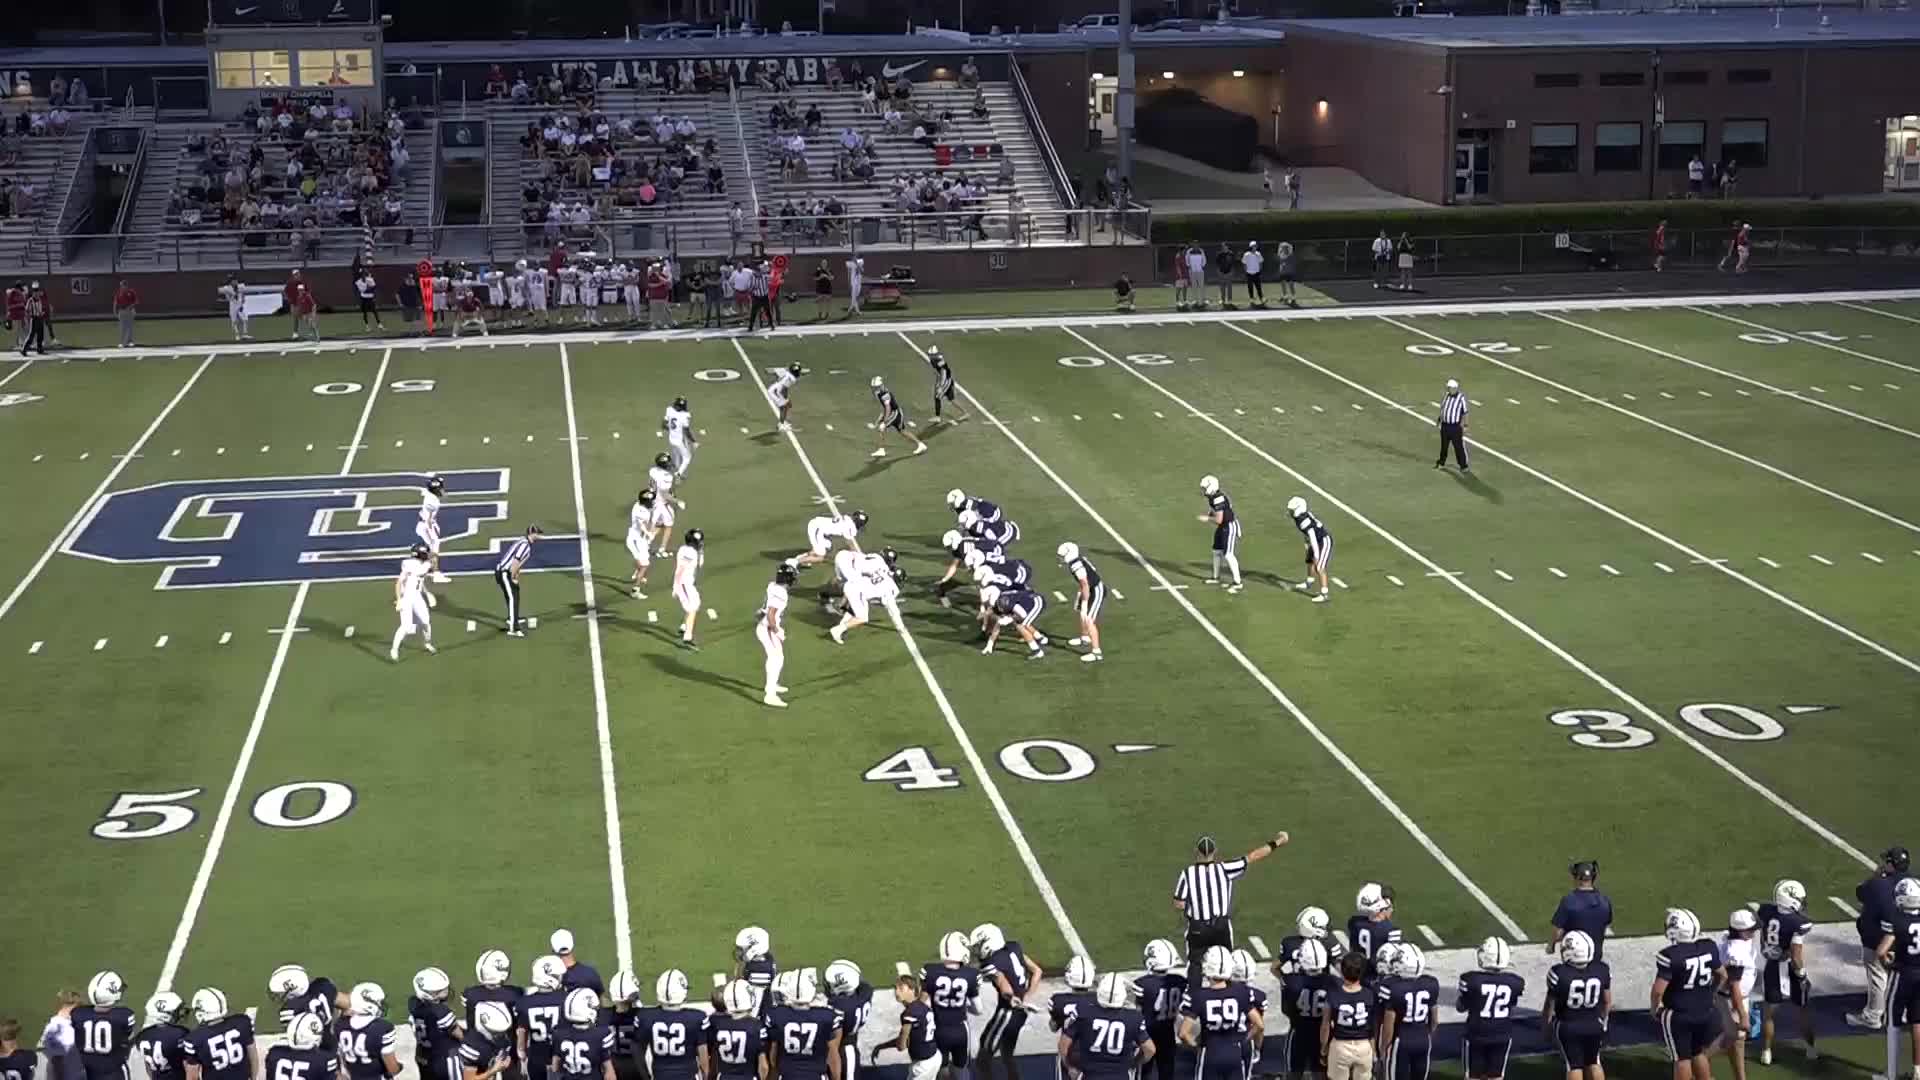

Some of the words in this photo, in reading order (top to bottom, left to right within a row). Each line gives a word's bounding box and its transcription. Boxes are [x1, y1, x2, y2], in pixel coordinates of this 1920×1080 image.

[614, 61, 664, 84] ALL
[1683, 953, 1713, 990] 75
[935, 976, 969, 1007] 23
[1404, 990, 1431, 1023] 16
[1480, 984, 1512, 1018] 72
[1567, 978, 1601, 1009] 60
[1205, 997, 1239, 1031] 59
[83, 1019, 113, 1054] 10
[207, 1028, 244, 1071] 56
[652, 1022, 686, 1056] 62
[717, 1029, 748, 1064] 27
[783, 1022, 818, 1056] 67
[1089, 1018, 1126, 1055] 70
[560, 1040, 593, 1075] 36
